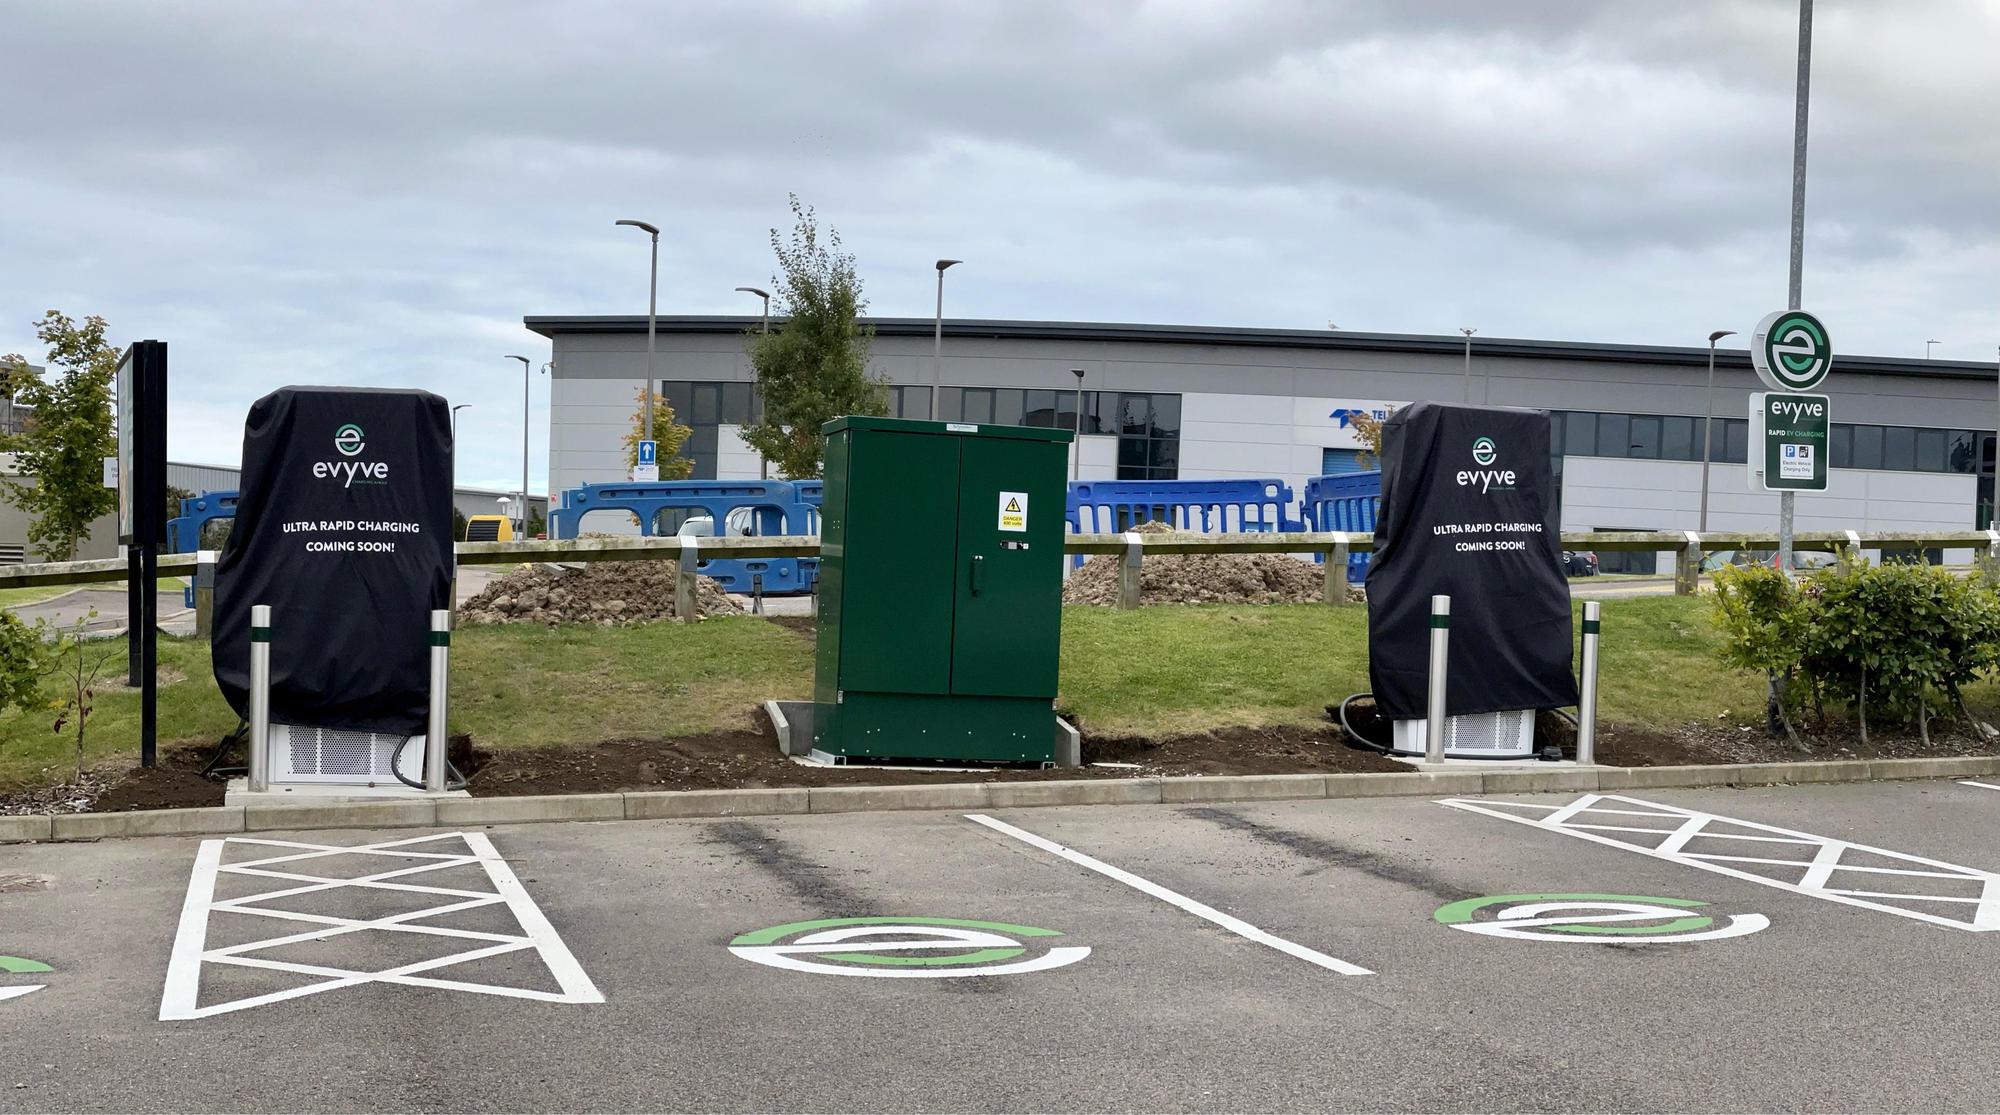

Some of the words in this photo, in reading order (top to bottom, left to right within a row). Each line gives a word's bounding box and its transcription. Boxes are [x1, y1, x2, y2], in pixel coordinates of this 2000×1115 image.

[1771, 401, 1823, 424] evyve
[1768, 429, 1786, 437] RAPID
[312, 461, 389, 489] evyve
[1456, 470, 1516, 494] evyve
[283, 521, 318, 533] ULTRA
[320, 520, 355, 531] RAPID
[357, 521, 420, 533] CHARGING
[1433, 524, 1463, 535] ULTRA
[1466, 522, 1492, 533] RAPID
[1494, 523, 1542, 533] CHARGING
[306, 541, 355, 552] COMING
[357, 542, 395, 553] SOON!
[1455, 542, 1493, 552] COMING
[1495, 541, 1526, 551] SOON!
